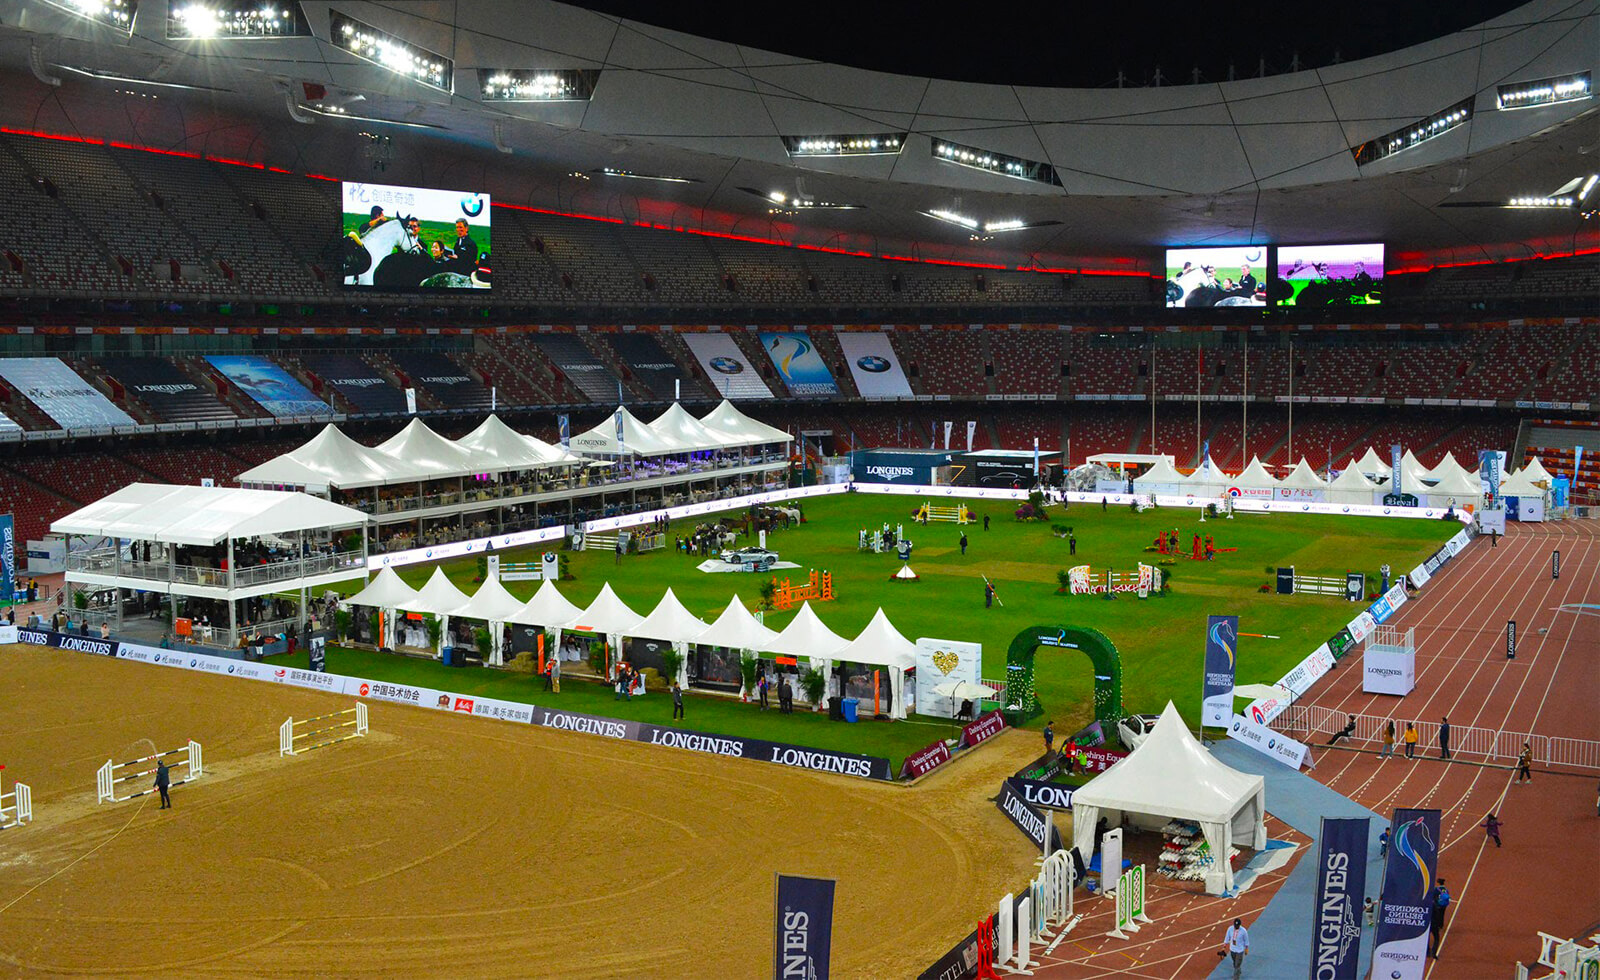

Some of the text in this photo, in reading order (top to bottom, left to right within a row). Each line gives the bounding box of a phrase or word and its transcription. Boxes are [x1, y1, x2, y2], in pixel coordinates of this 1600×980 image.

[134, 384, 197, 392] LONGINES
[866, 465, 913, 475] LONGINES
[18, 631, 48, 645] GINES
[59, 637, 111, 655] LONGINES
[290, 671, 333, 686] 国际赛事演出平台
[1368, 667, 1402, 676] LONGINES
[372, 684, 420, 701] 中国马术协会
[543, 712, 626, 739] LONGINES
[651, 729, 743, 757] LONGINES
[771, 747, 872, 777] LONGINES
[1076, 749, 1105, 761] Dshing
[1024, 785, 1072, 807] LON
[1003, 791, 1046, 844] LONGINES
[1317, 852, 1349, 980] ONGINES
[783, 911, 809, 980] NES
